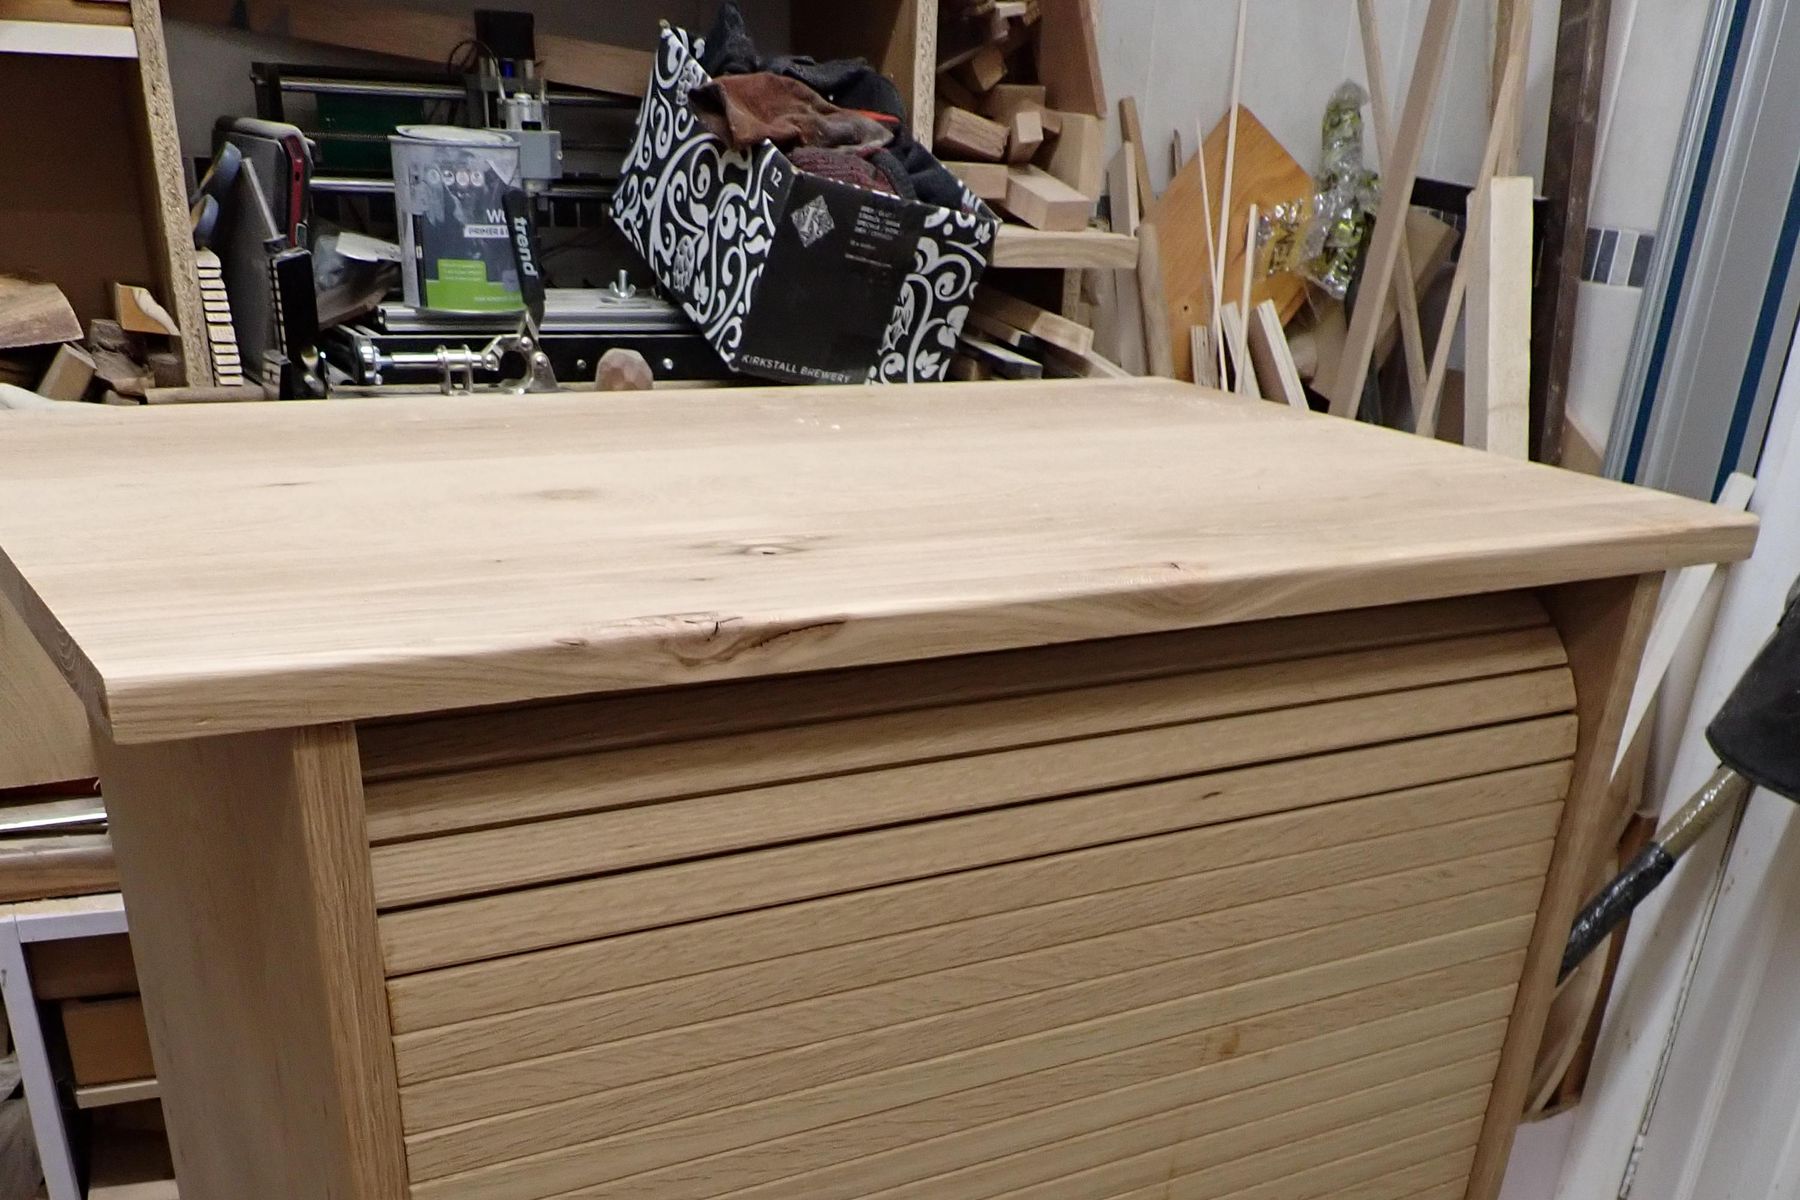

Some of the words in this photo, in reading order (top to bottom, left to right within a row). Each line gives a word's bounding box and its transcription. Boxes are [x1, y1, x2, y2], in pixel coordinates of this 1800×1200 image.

[770, 166, 783, 188] 12
[514, 216, 539, 279] trend
[741, 354, 798, 374] KIRKSTALL
[800, 366, 853, 384] BREWERY
